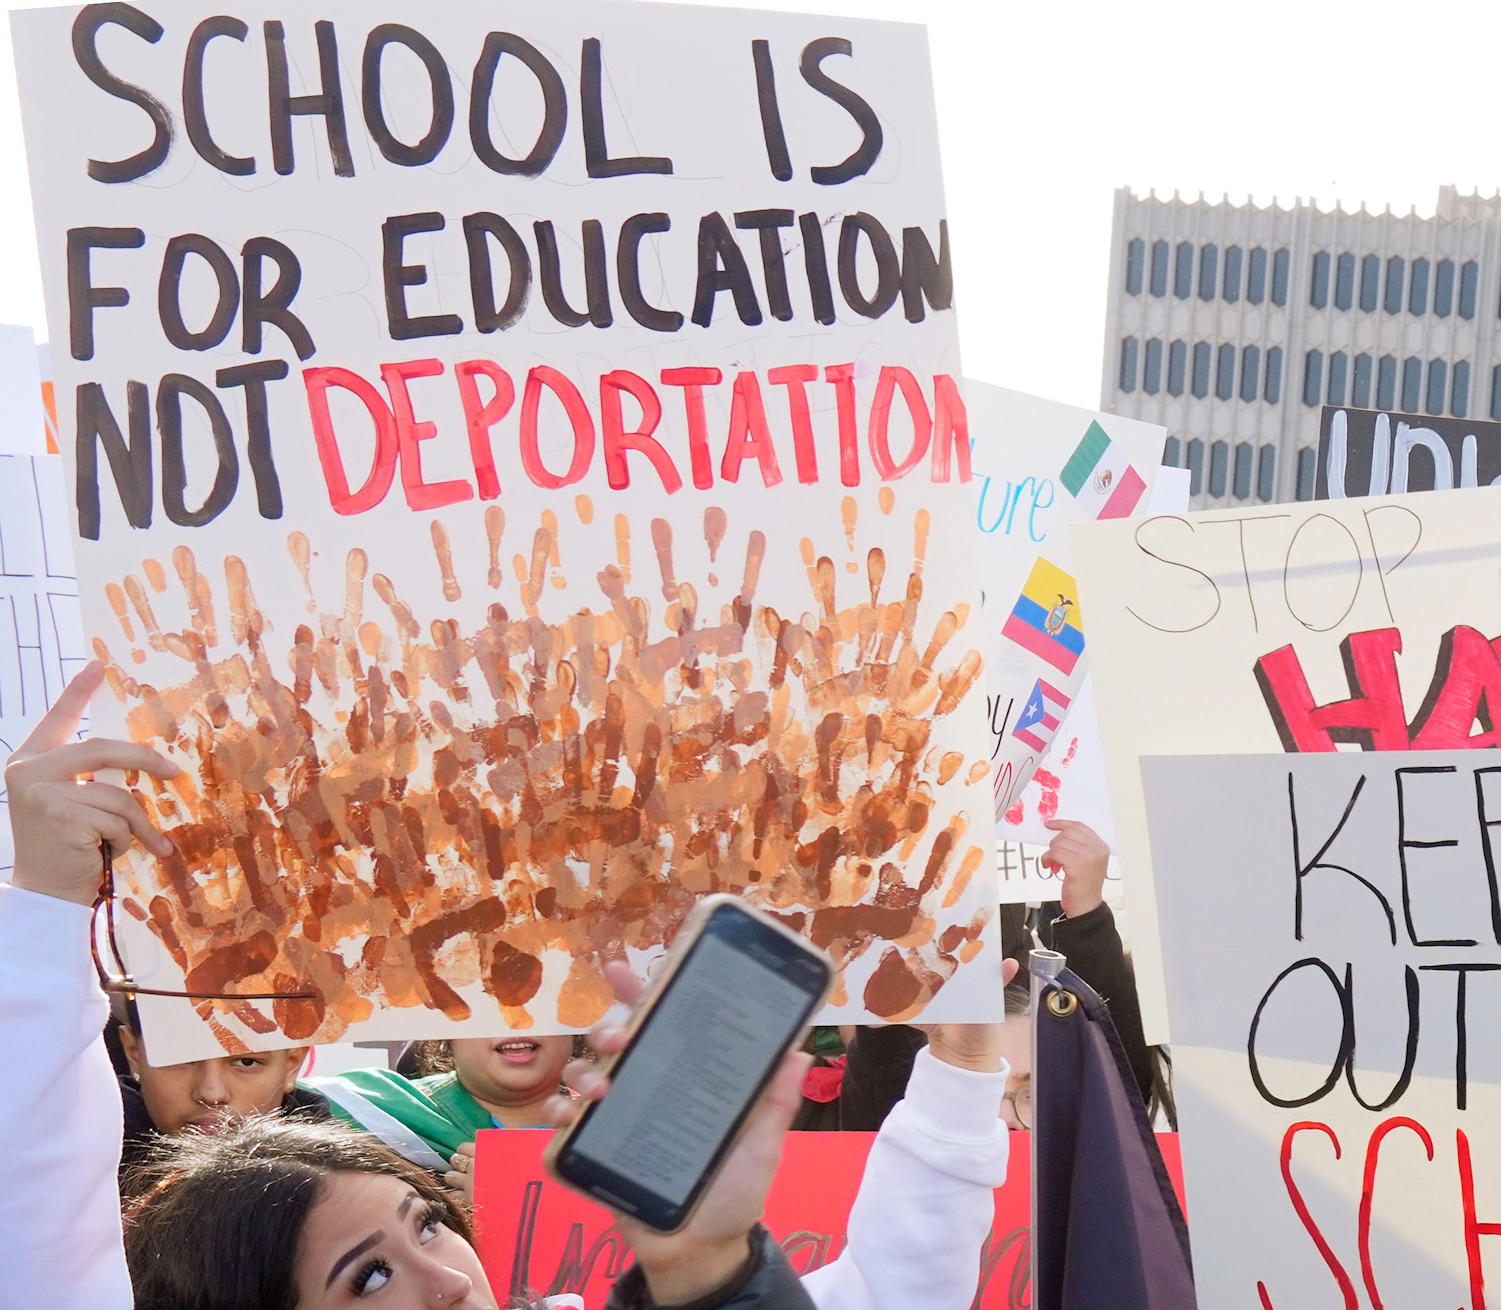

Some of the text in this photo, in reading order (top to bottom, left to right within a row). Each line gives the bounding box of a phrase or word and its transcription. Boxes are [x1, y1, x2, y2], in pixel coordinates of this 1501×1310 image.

[71, 2, 884, 186] SCHOOL IS
[66, 209, 956, 361] FOR EDUCATION
[77, 360, 290, 540] NOT
[303, 359, 973, 516] DEPORTATION
[1126, 503, 1422, 634] STOP
